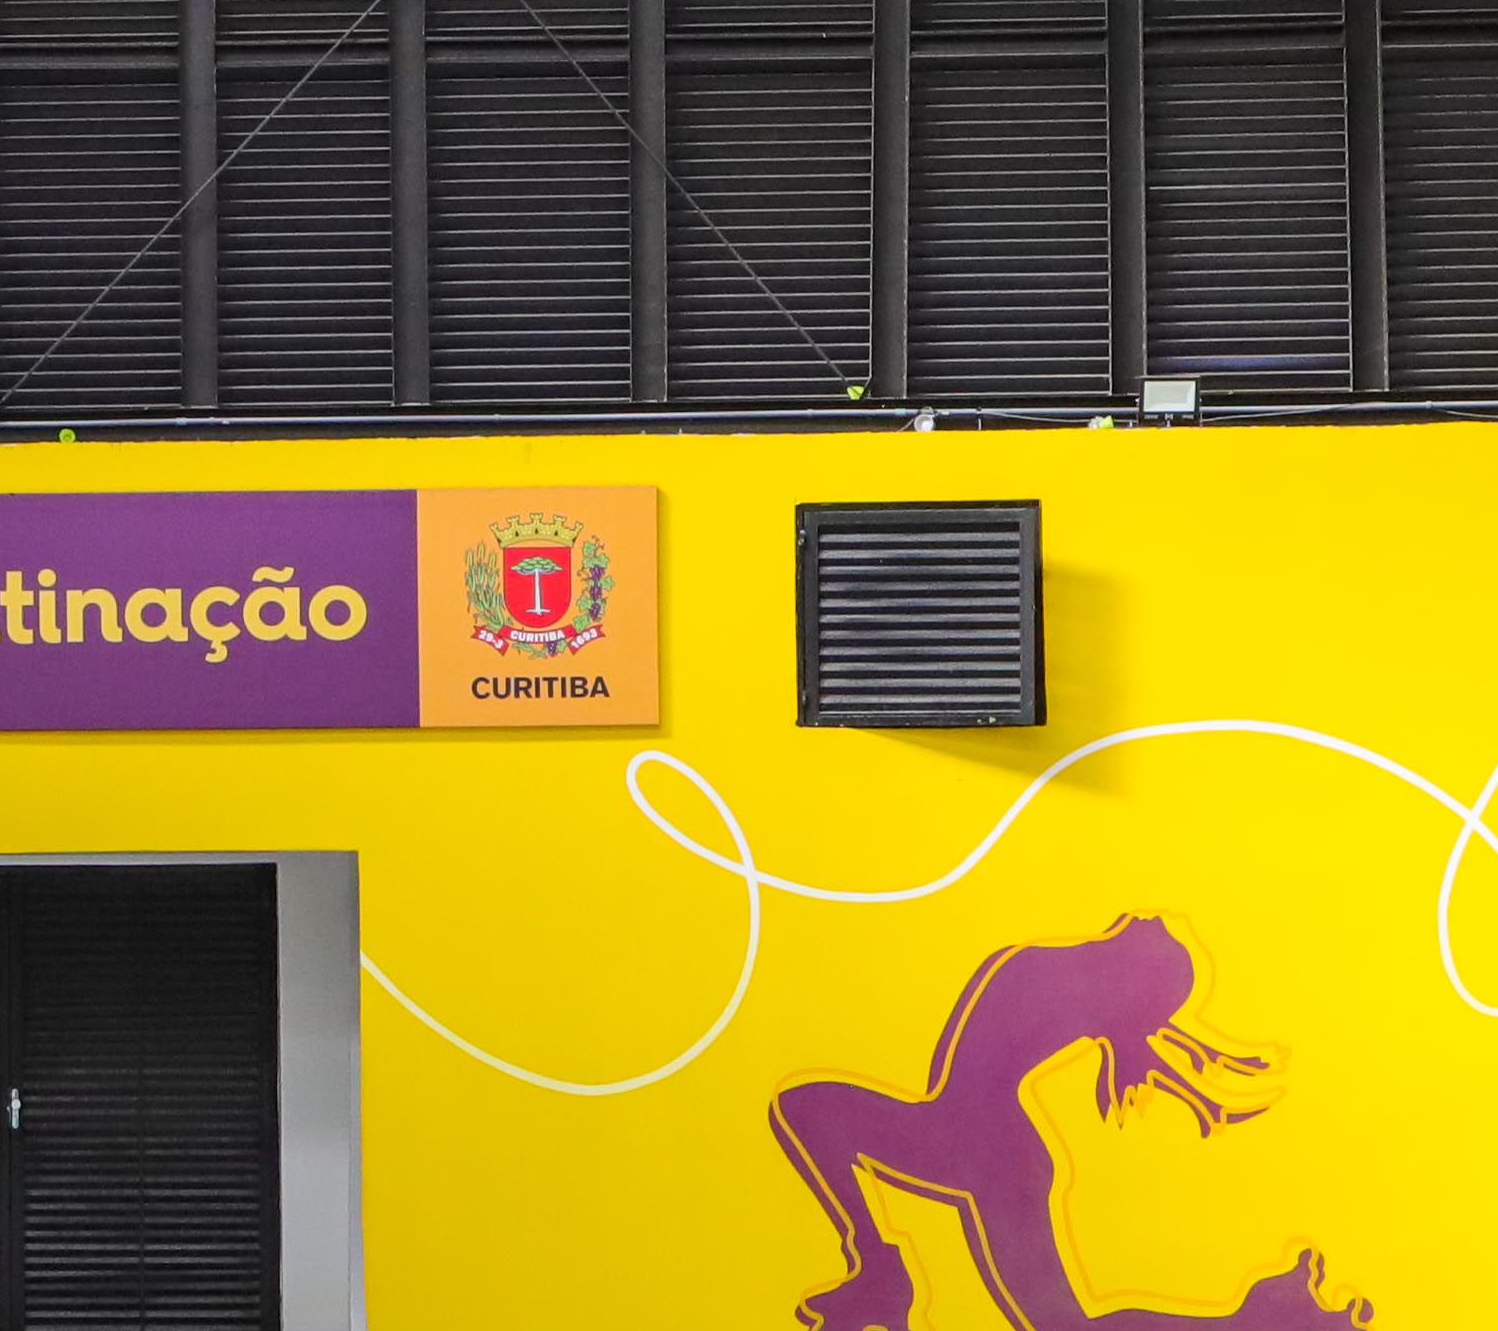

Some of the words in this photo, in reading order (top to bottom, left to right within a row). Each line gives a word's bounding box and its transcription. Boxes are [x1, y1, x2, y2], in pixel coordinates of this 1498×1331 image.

[510, 630, 566, 643] CURITIBA
[571, 628, 598, 648] 1693
[471, 677, 610, 699] CURITIBA
